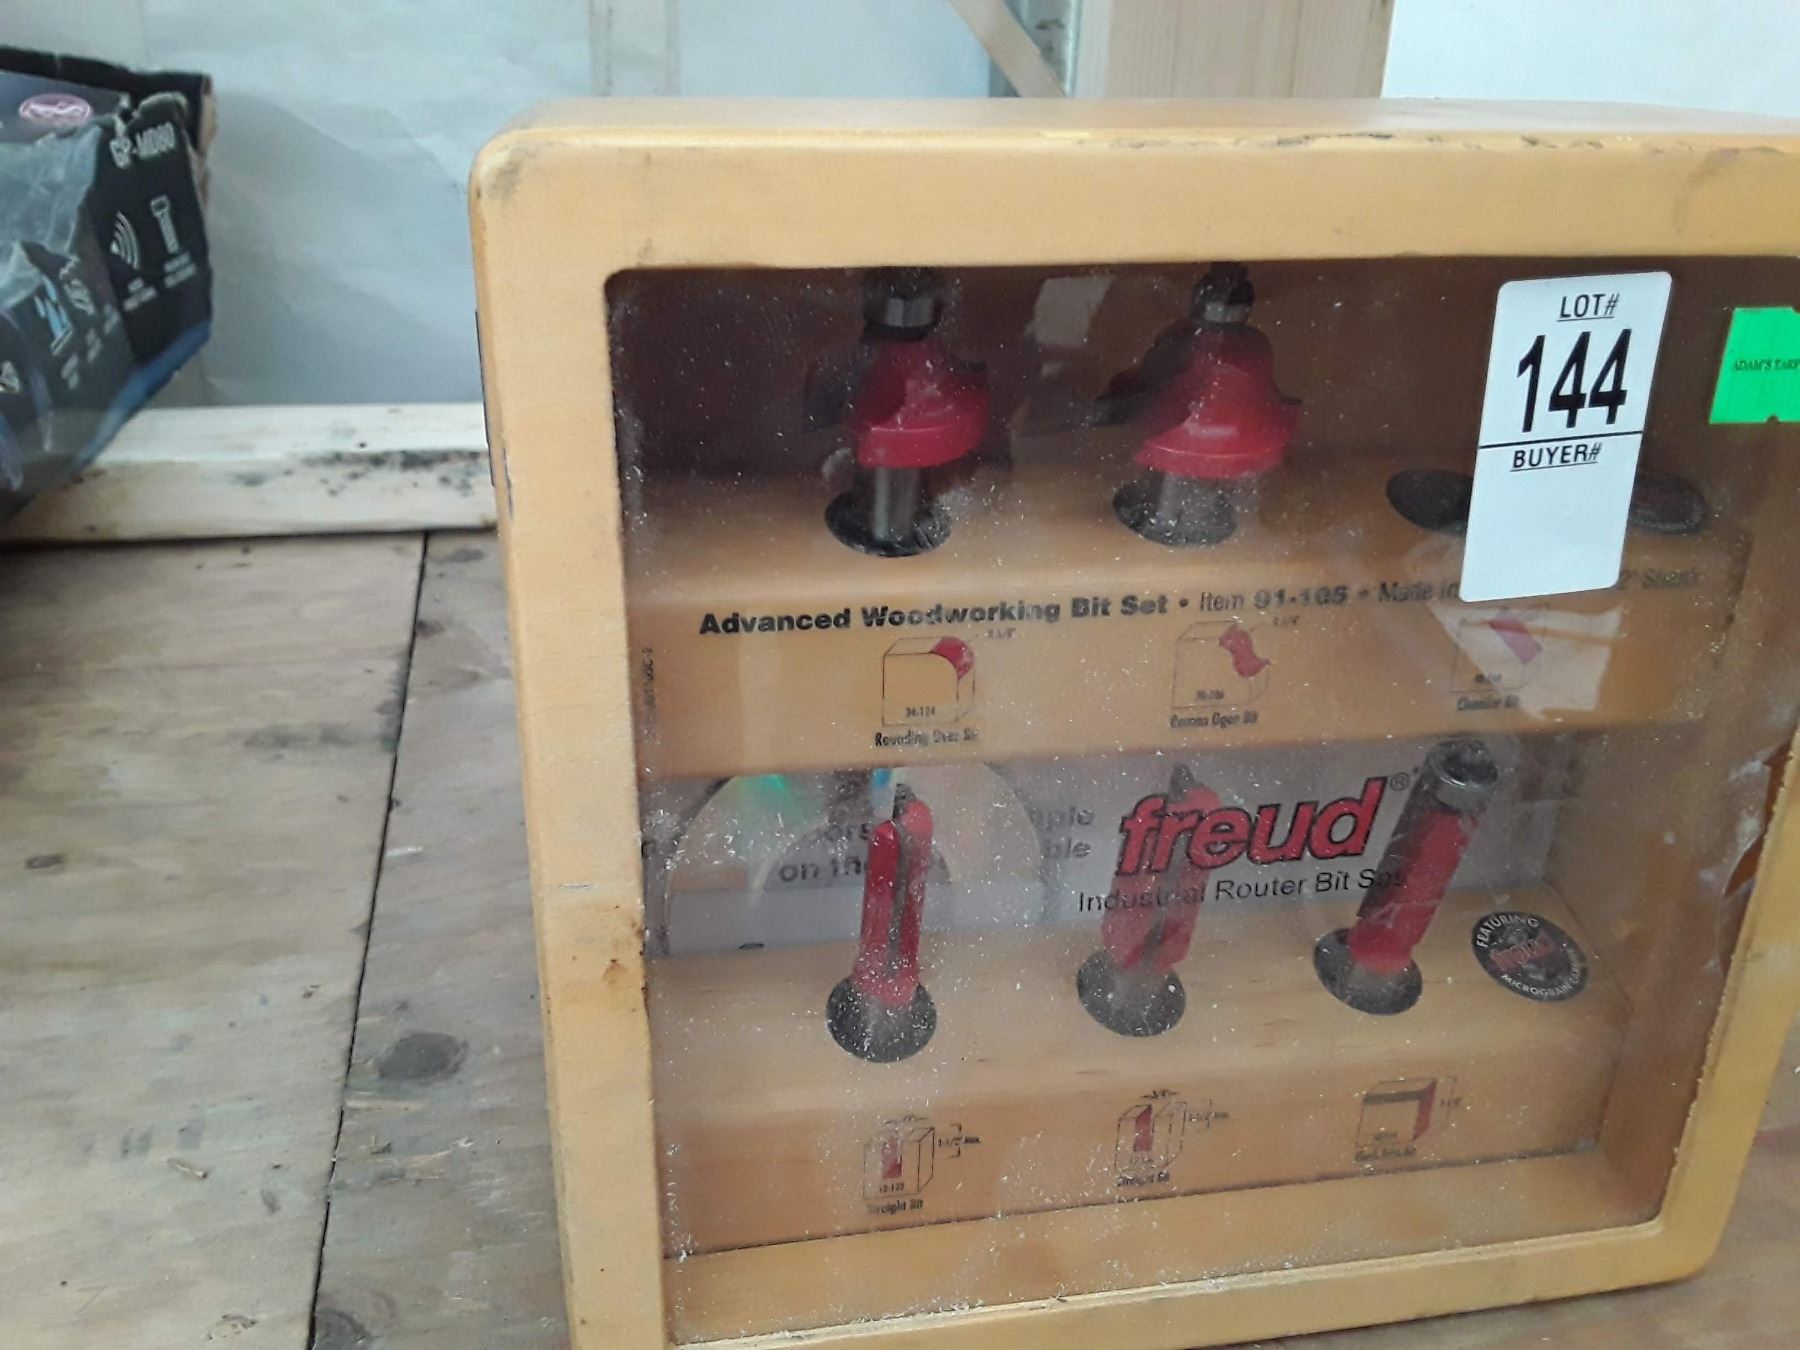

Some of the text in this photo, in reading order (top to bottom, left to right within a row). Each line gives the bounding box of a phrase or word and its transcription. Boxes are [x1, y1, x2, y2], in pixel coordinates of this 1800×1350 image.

[1559, 293, 1620, 318] LOT#
[1516, 328, 1632, 432] 144
[1512, 443, 1601, 468] BUYER#
[699, 608, 851, 635] Advanced
[861, 600, 1060, 627] Woodworking
[1071, 597, 1111, 617] Bit
[1120, 595, 1168, 614] Set
[1200, 592, 1244, 611] Item
[1254, 585, 1349, 608] 91-105
[1116, 776, 1388, 876] freud
[779, 862, 820, 882] on
[1215, 877, 1308, 901] Router
[1315, 870, 1350, 892] Bit
